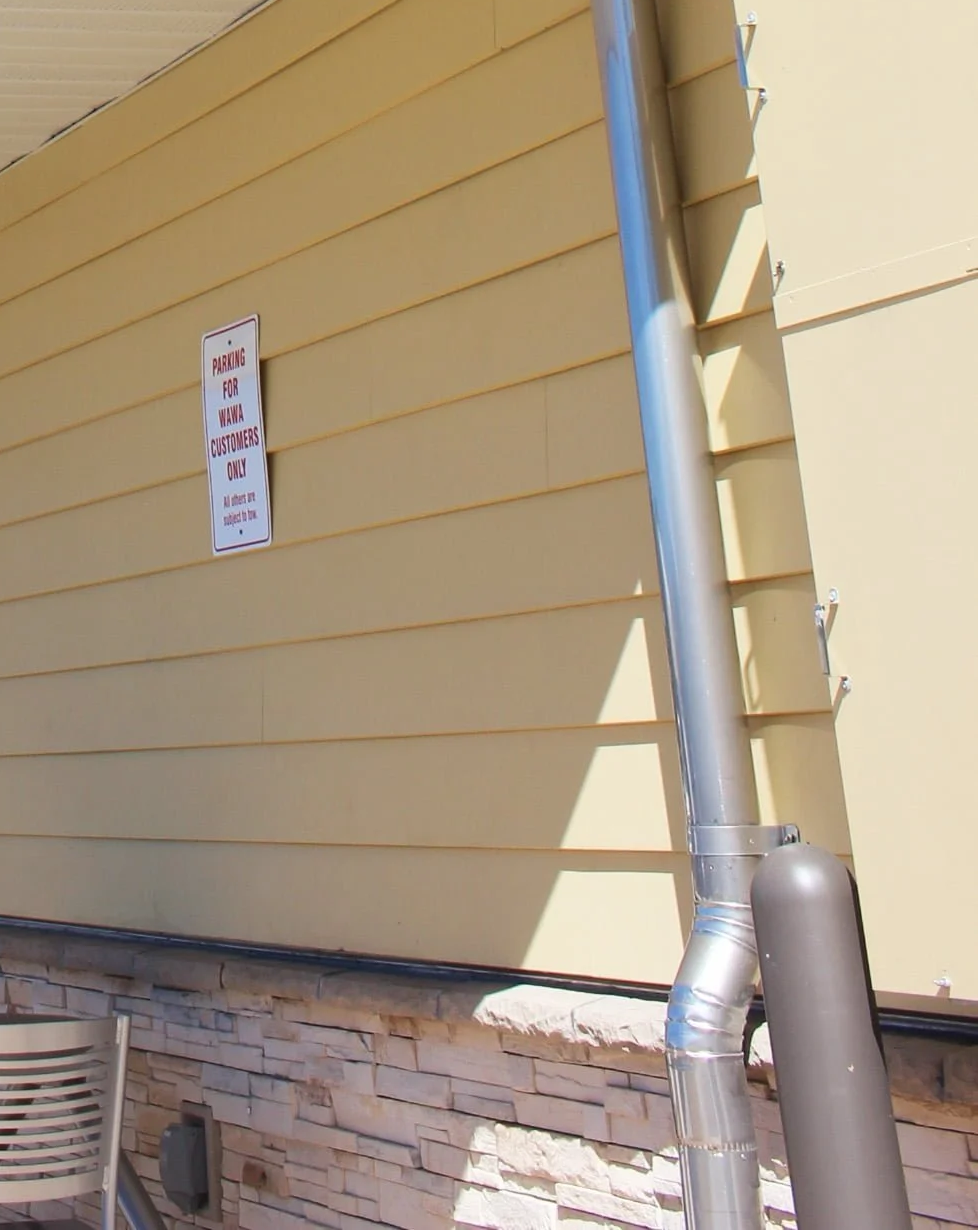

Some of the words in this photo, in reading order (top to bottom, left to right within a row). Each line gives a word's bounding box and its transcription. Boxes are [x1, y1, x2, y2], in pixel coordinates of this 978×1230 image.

[212, 347, 246, 377] PARKING
[223, 377, 239, 400] FOR
[218, 403, 245, 428] WAWA
[210, 426, 260, 458] CUSTOMERS
[227, 457, 247, 481] ONLY
[223, 495, 231, 508] All
[231, 492, 247, 507] others
[247, 491, 256, 504] are
[223, 511, 241, 528] subject
[241, 510, 247, 523] to
